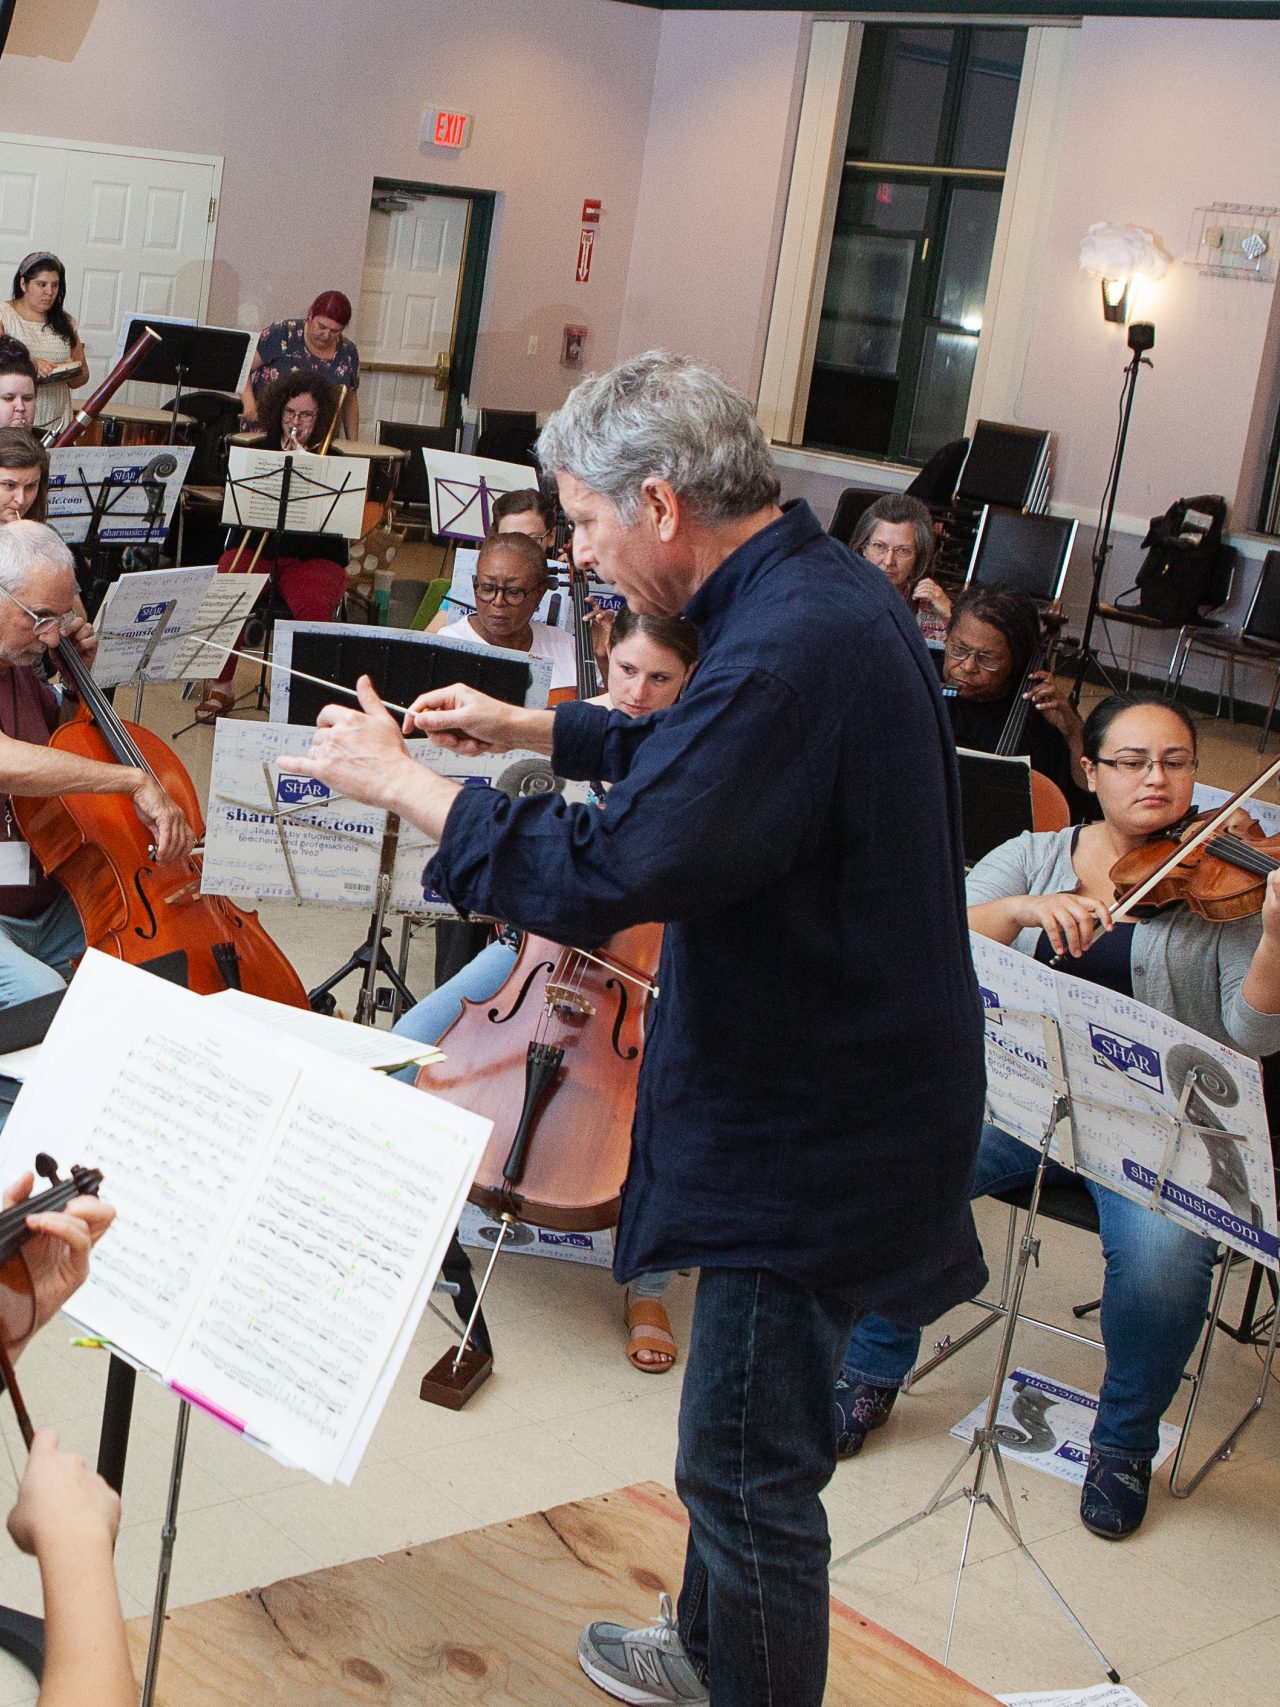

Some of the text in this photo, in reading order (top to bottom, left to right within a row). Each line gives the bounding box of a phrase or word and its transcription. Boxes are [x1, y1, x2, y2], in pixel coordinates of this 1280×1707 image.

[434, 112, 467, 148] EXIT
[114, 472, 136, 481] SHAR
[102, 527, 160, 537] sharmusic.cm
[598, 598, 622, 610] HAR
[142, 606, 162, 616] SHAR
[284, 782, 323, 796] SHAR
[290, 831, 300, 840] by
[238, 835, 278, 845] teachers
[300, 840, 358, 853] professionals
[301, 848, 320, 857] 1962
[1101, 1039, 1152, 1074] SHAR
